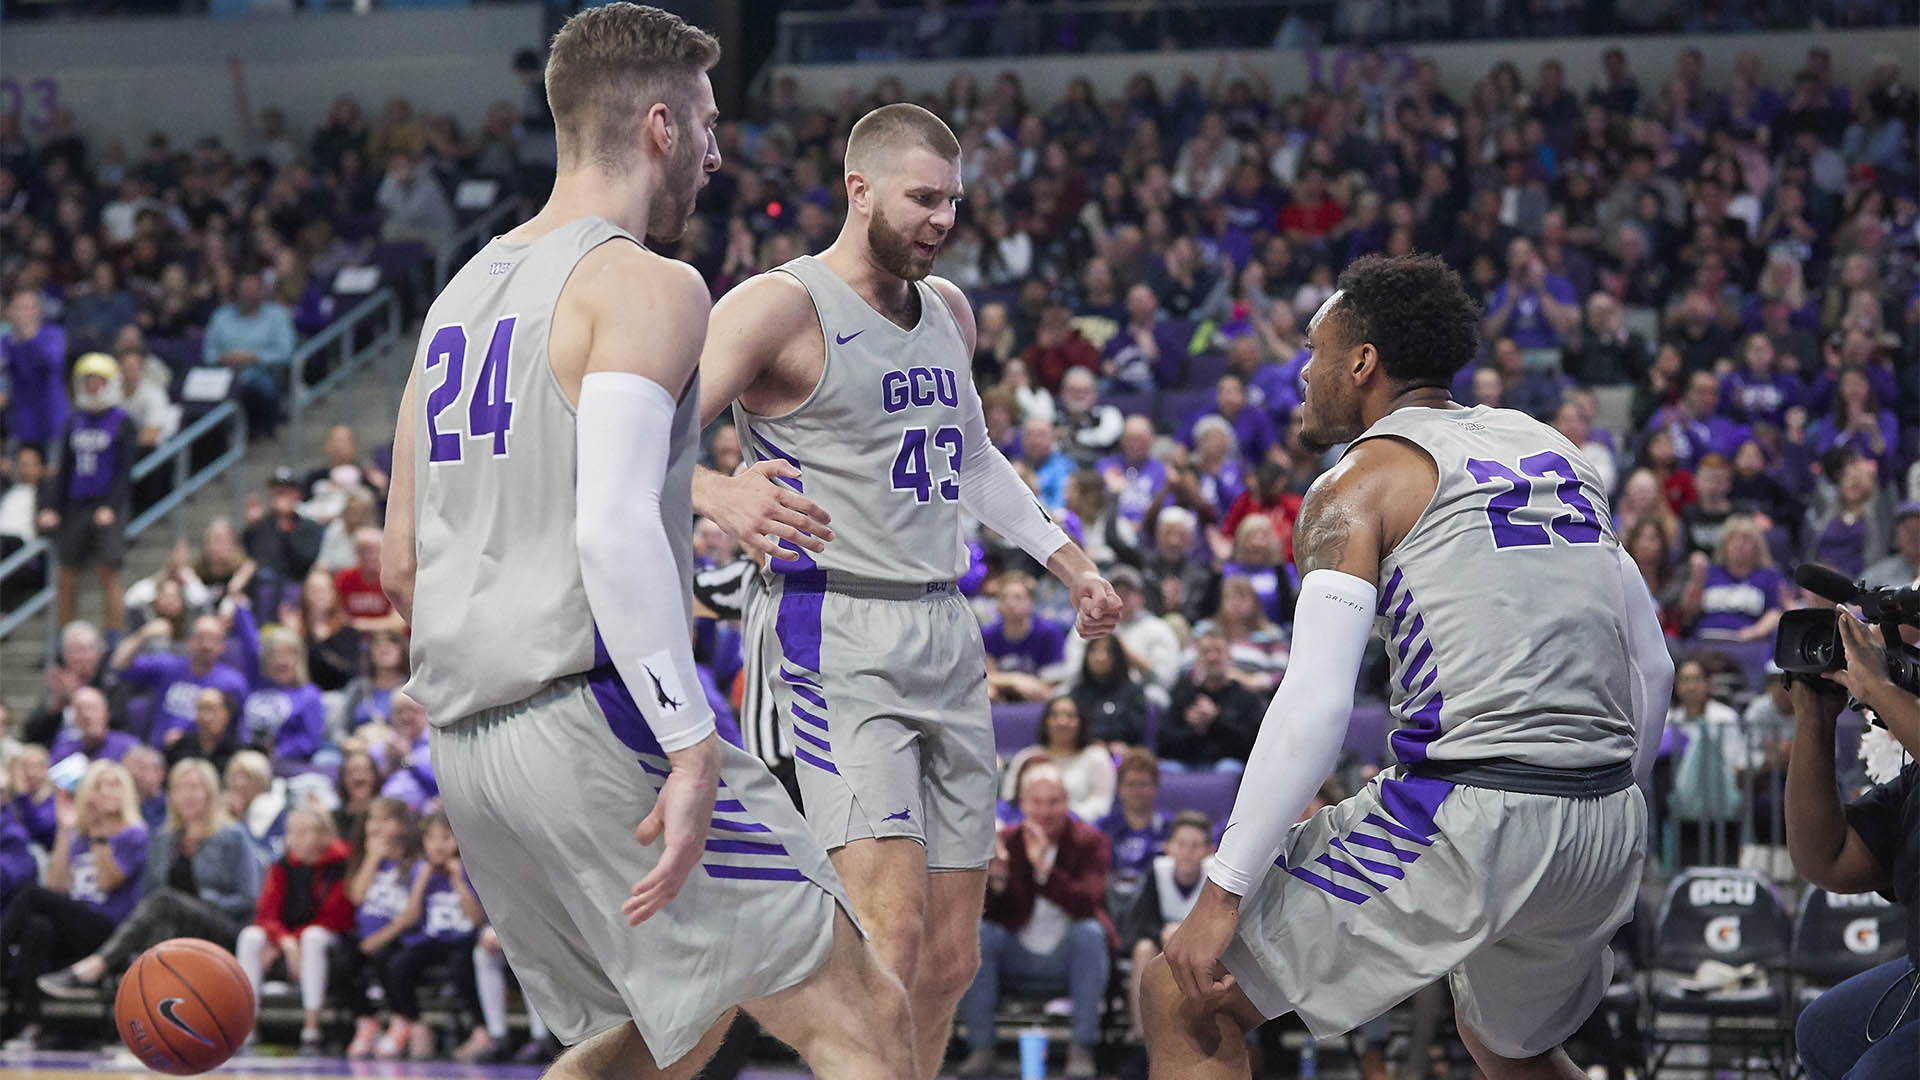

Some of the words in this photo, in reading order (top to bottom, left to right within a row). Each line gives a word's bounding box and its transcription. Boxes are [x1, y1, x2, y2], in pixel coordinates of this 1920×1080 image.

[424, 313, 519, 466] 24
[881, 366, 959, 415] GCU
[889, 424, 964, 505] 43
[1464, 449, 1603, 552] 23
[1688, 879, 1757, 907] GCU
